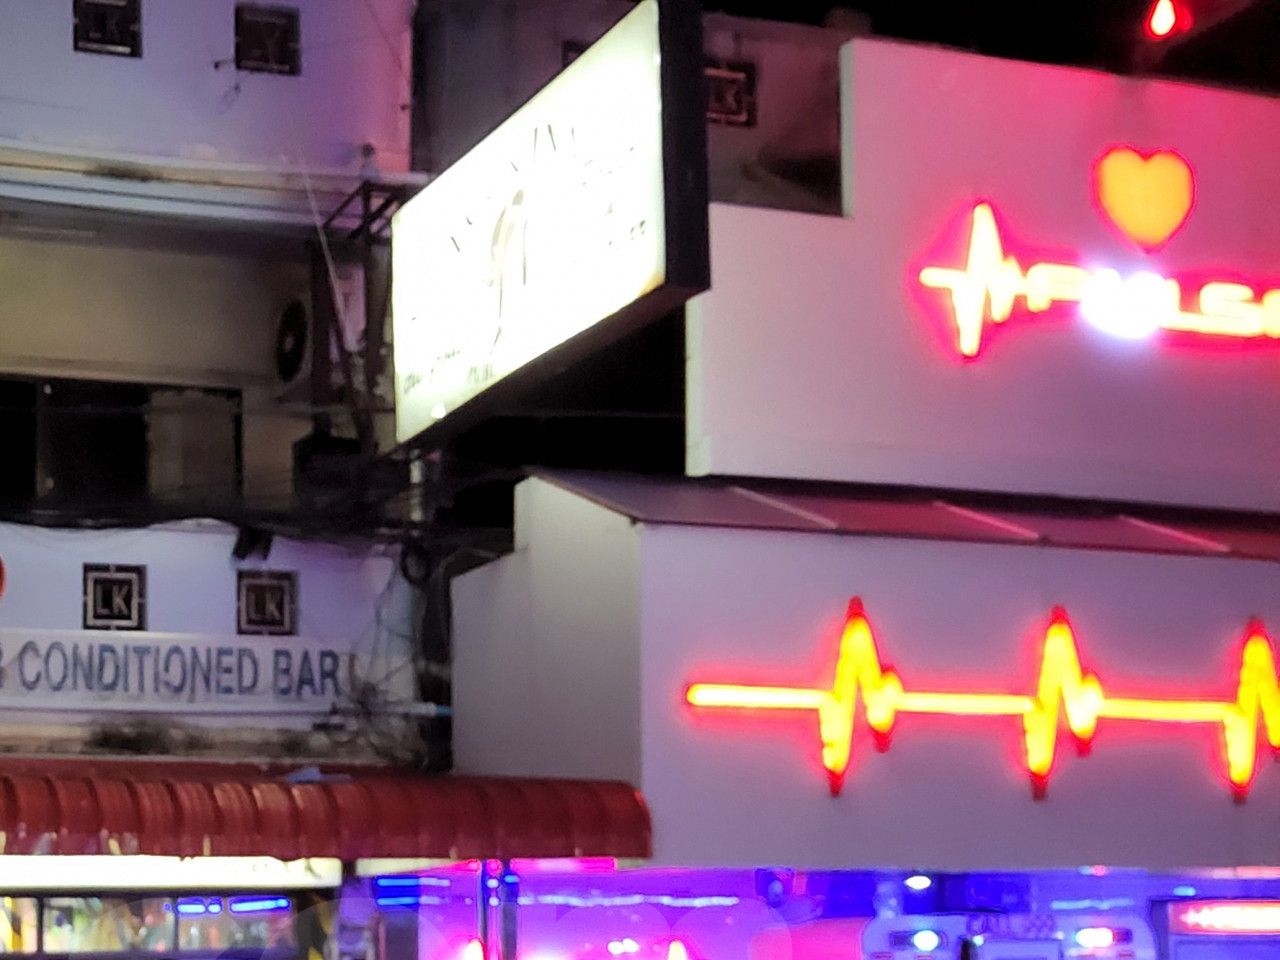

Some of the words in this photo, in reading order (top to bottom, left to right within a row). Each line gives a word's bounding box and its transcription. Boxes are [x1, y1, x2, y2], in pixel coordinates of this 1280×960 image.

[94, 583, 131, 616] LK
[248, 590, 282, 621] LK
[20, 639, 259, 696] CONDITIONED
[272, 648, 341, 697] BAR
